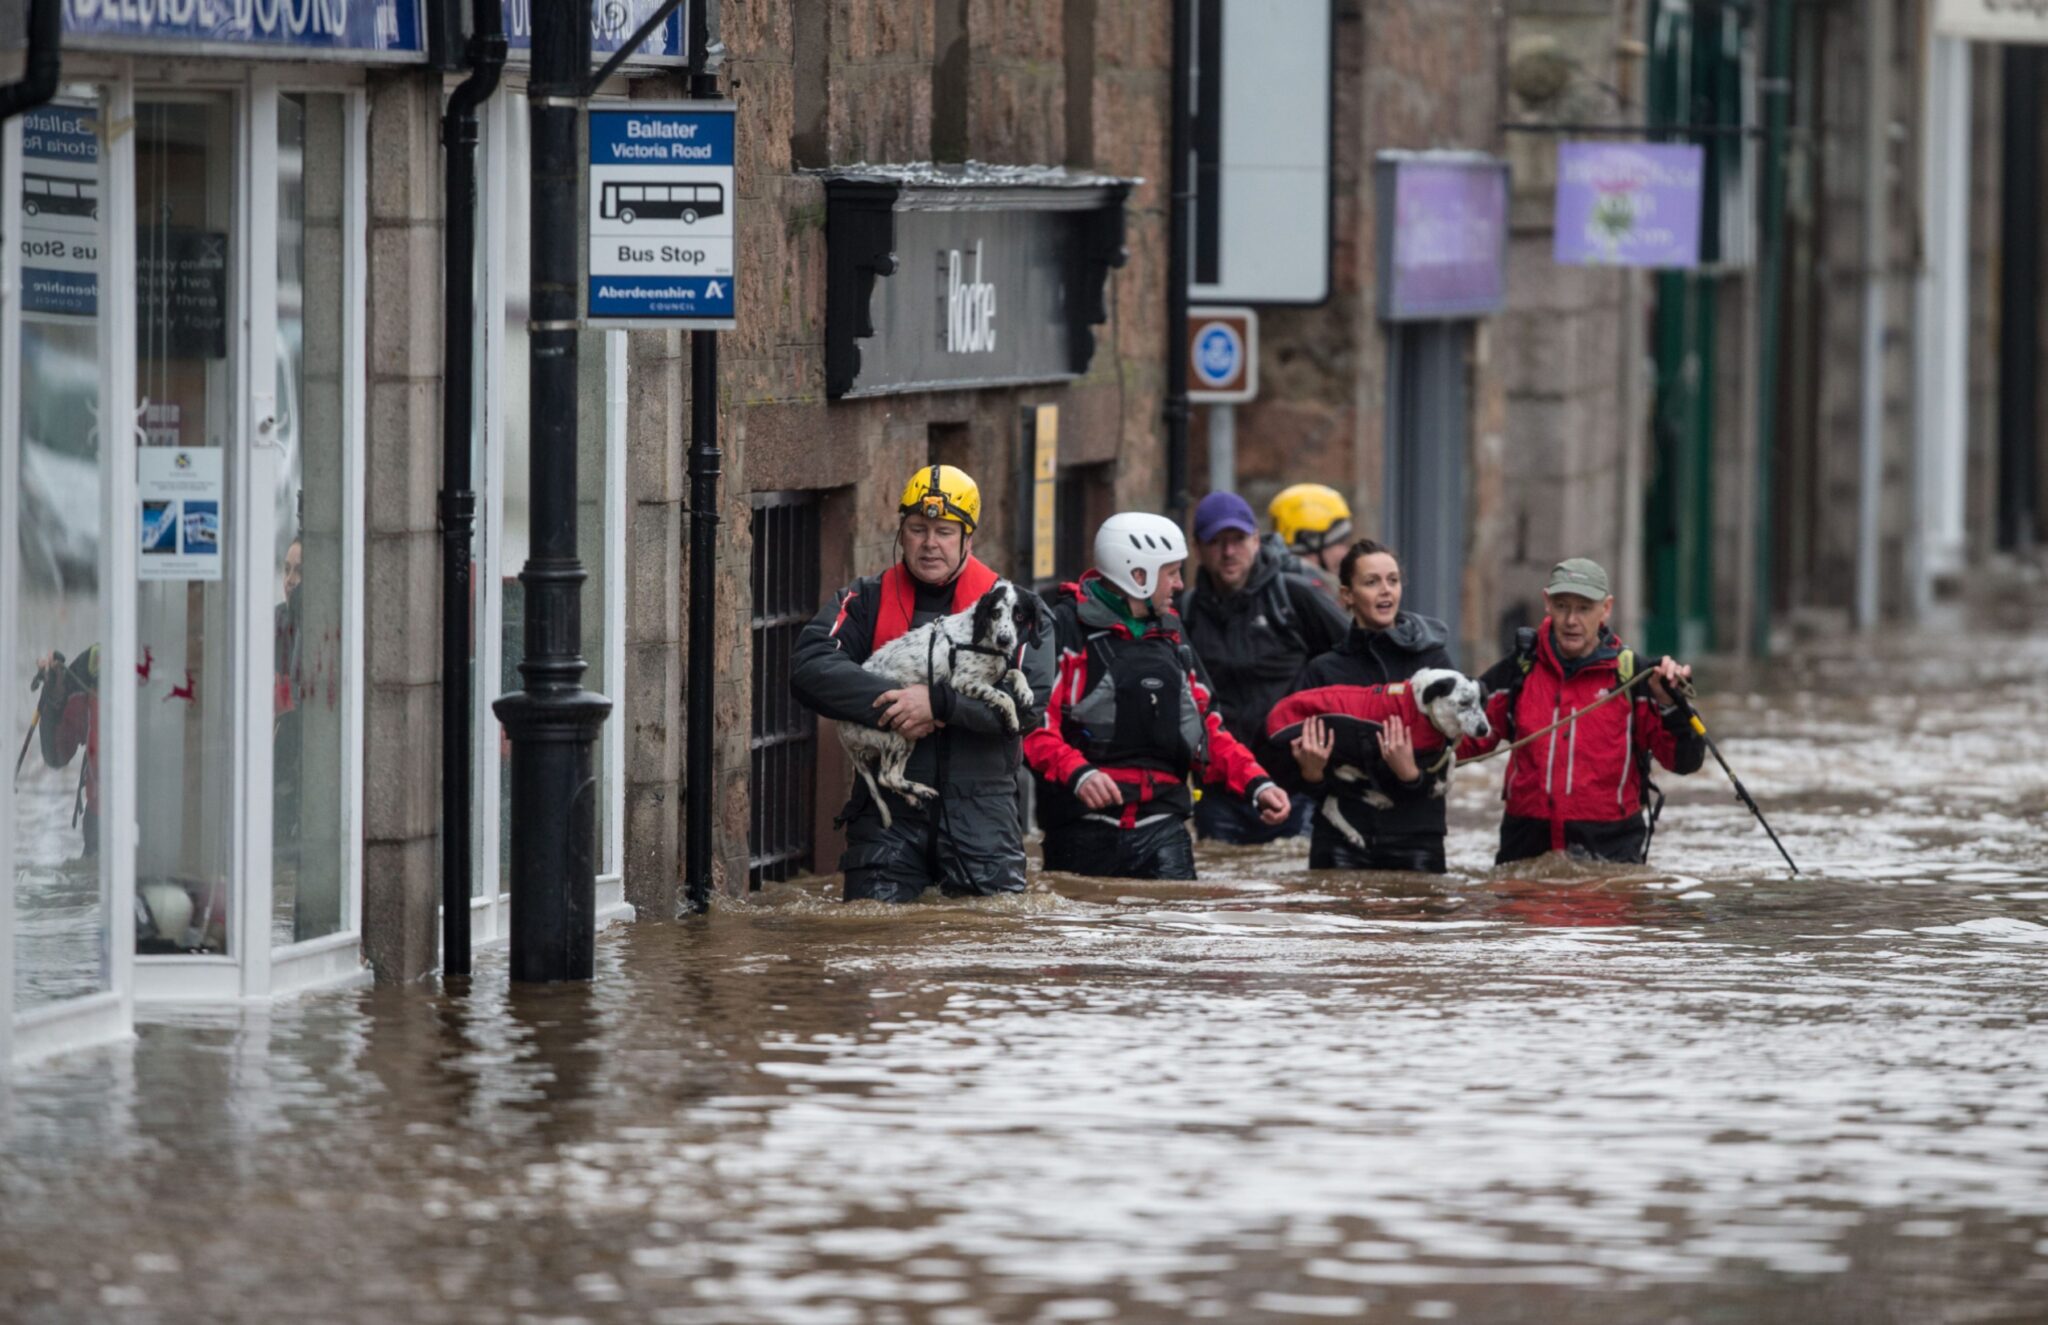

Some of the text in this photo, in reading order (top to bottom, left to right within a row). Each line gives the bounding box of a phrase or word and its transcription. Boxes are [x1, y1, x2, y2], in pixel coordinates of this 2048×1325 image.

[627, 120, 698, 138] Ballater
[611, 143, 712, 158] Victoria Road
[618, 246, 706, 266] Bus Stop
[598, 285, 696, 299] Aberdeenshire
[649, 302, 696, 311] COUNCIL
